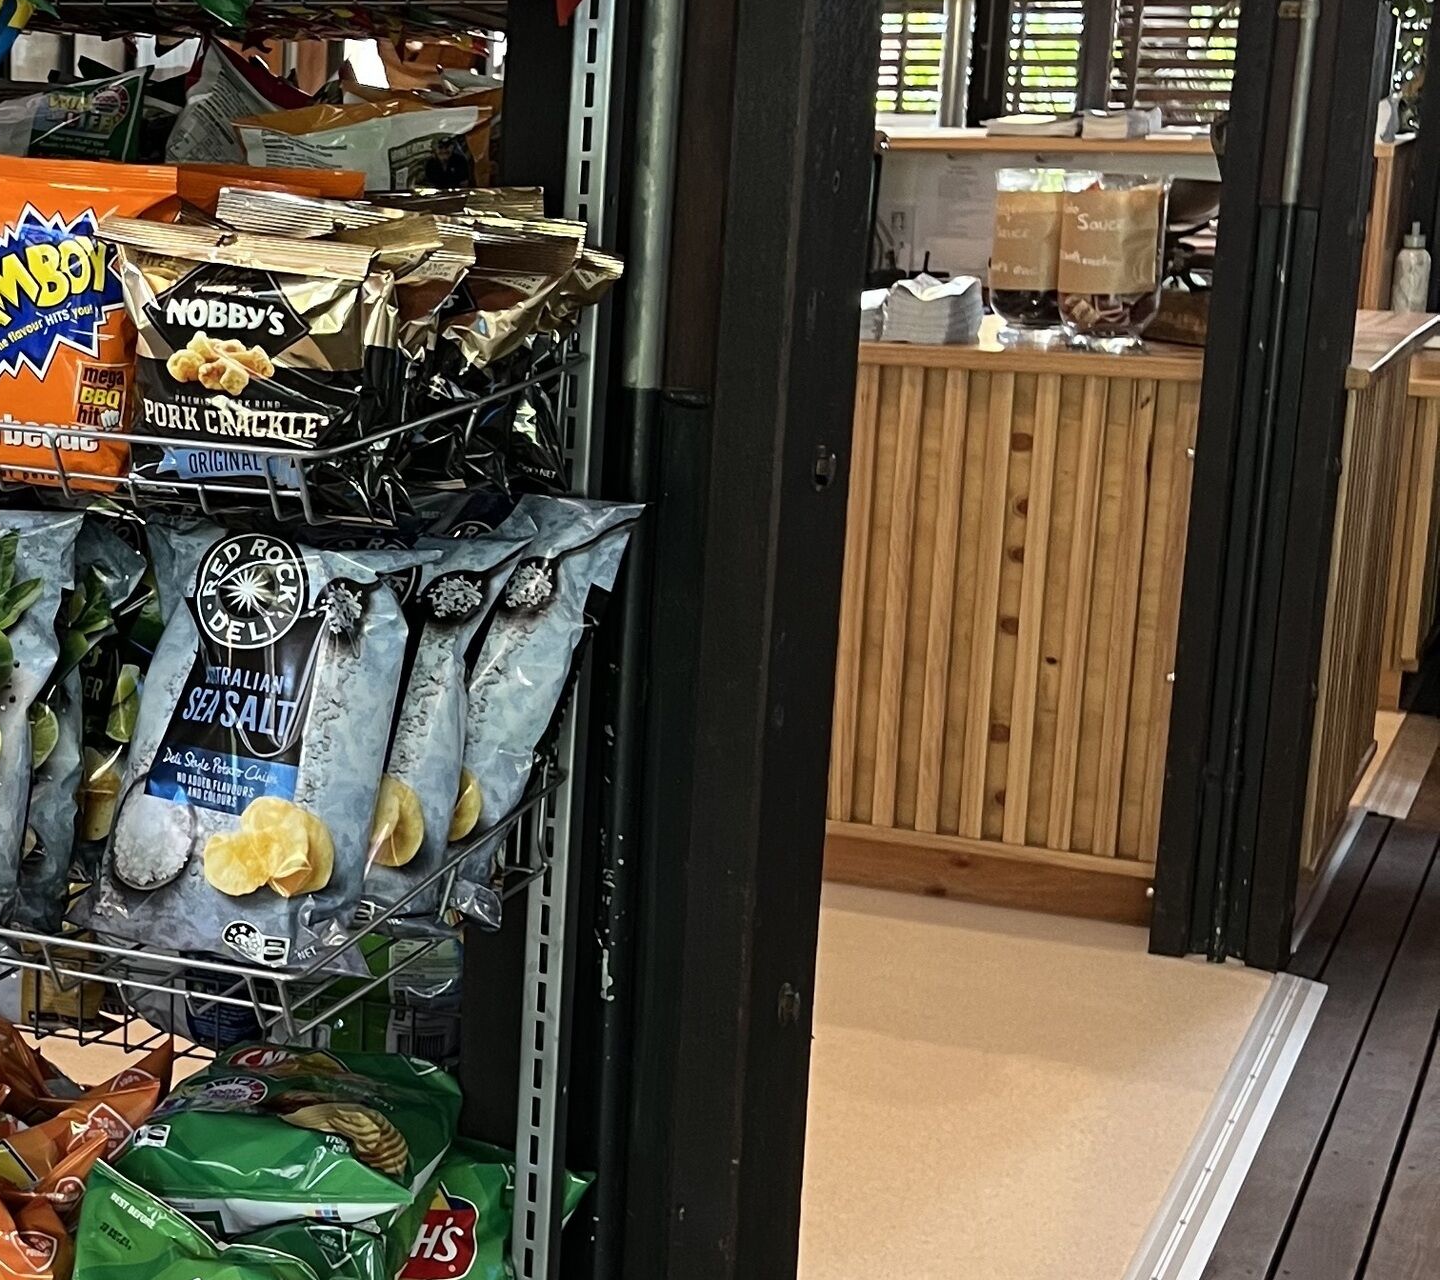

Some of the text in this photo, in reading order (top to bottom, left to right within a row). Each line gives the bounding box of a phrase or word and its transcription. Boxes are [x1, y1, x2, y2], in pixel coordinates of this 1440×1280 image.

[8, 310, 71, 343] flavour HITS
[166, 298, 286, 336] NOBBY'S
[82, 365, 125, 387] mega
[80, 387, 121, 409] BBQ
[143, 398, 319, 440] PORK CRACKLE
[188, 449, 262, 474] ORIGINAL
[202, 539, 298, 608] RED ROCK
[209, 612, 279, 643] DELI
[182, 686, 297, 738] SEA SALT
[187, 774, 256, 798] ADDED FLAVOURS
[187, 786, 238, 809] AND COLOURS
[110, 1191, 156, 1229] BEST BEFORE
